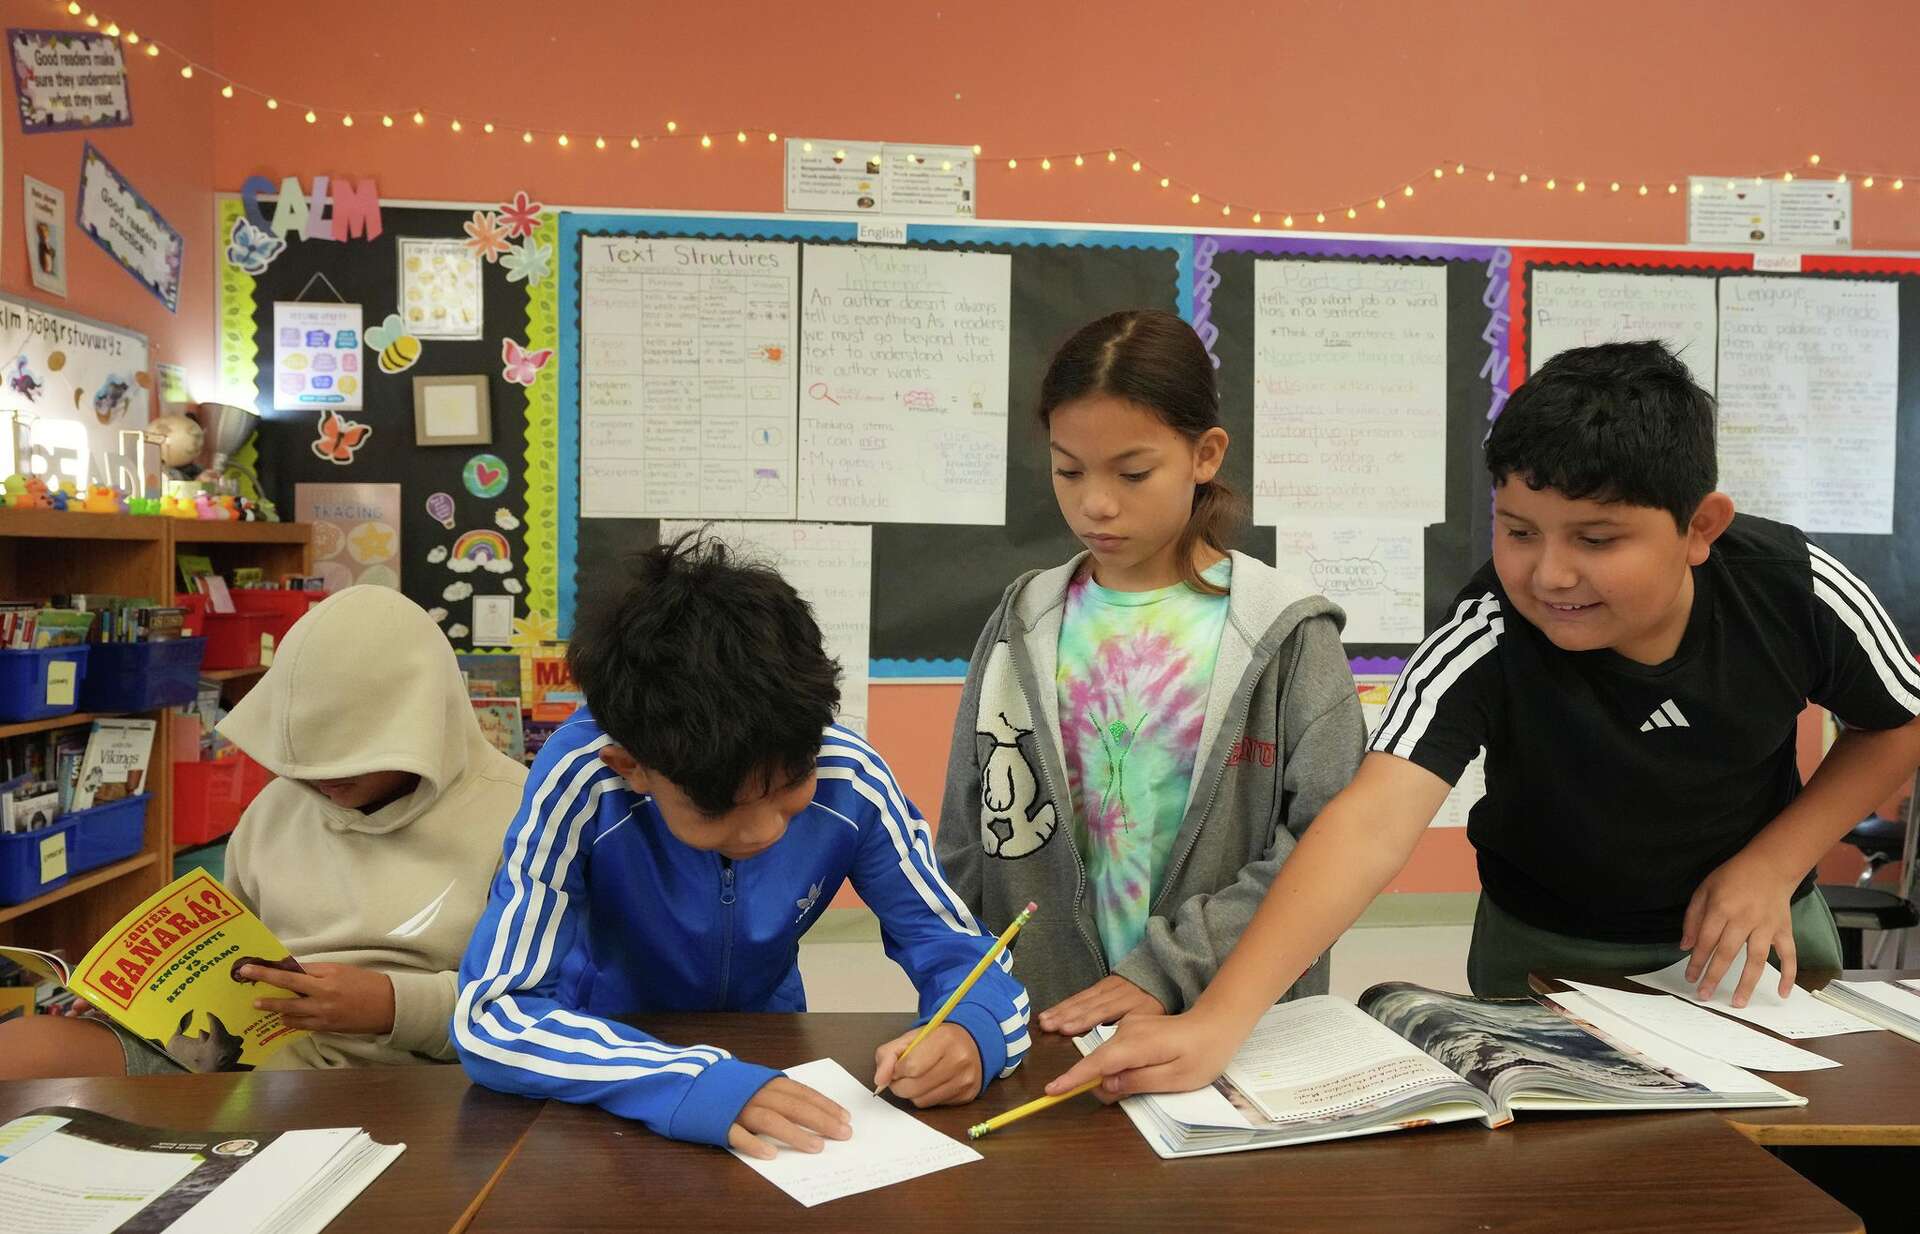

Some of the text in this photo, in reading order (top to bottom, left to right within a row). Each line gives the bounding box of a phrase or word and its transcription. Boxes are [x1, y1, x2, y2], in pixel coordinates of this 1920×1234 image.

[34, 49, 115, 66] Good readers make
[35, 72, 121, 90] sure they understand
[48, 92, 72, 107] what
[73, 92, 92, 109] they
[101, 187, 124, 218] Good
[241, 175, 383, 243] CALM
[860, 225, 903, 241] English
[601, 243, 780, 267] Text Structures
[810, 288, 832, 306] An
[843, 294, 891, 308] author
[954, 297, 997, 316] always
[803, 308, 828, 324] tell
[832, 314, 849, 327] us
[928, 313, 945, 329] As
[802, 329, 990, 348] we must go beyond the
[803, 344, 835, 358] text
[847, 344, 863, 359] to
[870, 347, 944, 363] understand
[804, 360, 824, 376] the
[833, 361, 880, 378] author
[101, 749, 140, 769] Vikings
[99, 889, 232, 1001] GANARÁ?
[149, 930, 226, 992] RINOCERONTE
